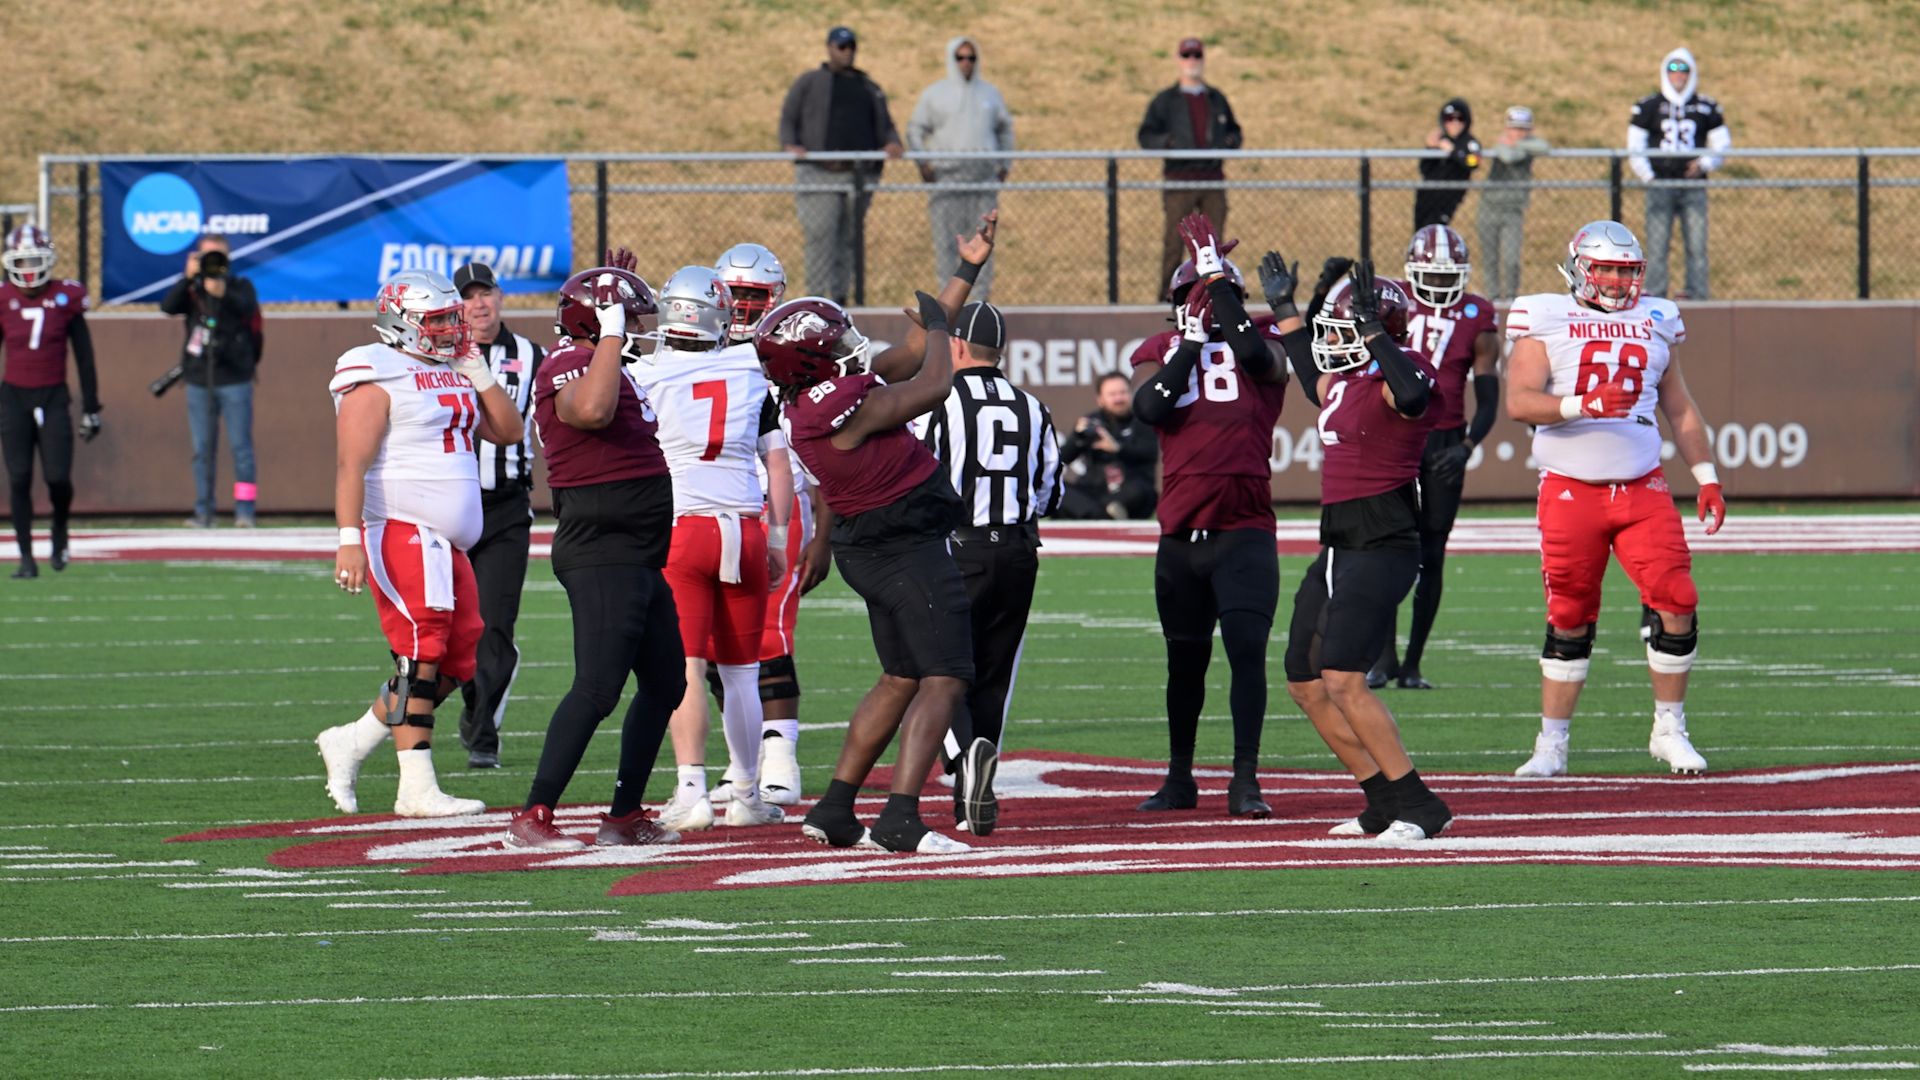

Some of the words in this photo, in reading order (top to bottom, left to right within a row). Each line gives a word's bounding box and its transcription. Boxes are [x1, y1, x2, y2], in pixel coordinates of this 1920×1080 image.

[21, 306, 45, 350] 7
[1407, 313, 1456, 370] 17
[1569, 323, 1652, 341] NICHOLLS
[808, 380, 836, 404] 96
[1575, 340, 1648, 410] 68
[437, 393, 475, 453] 71
[692, 380, 728, 461] 7
[976, 406, 1018, 471] C
[1318, 380, 1341, 446] 2
